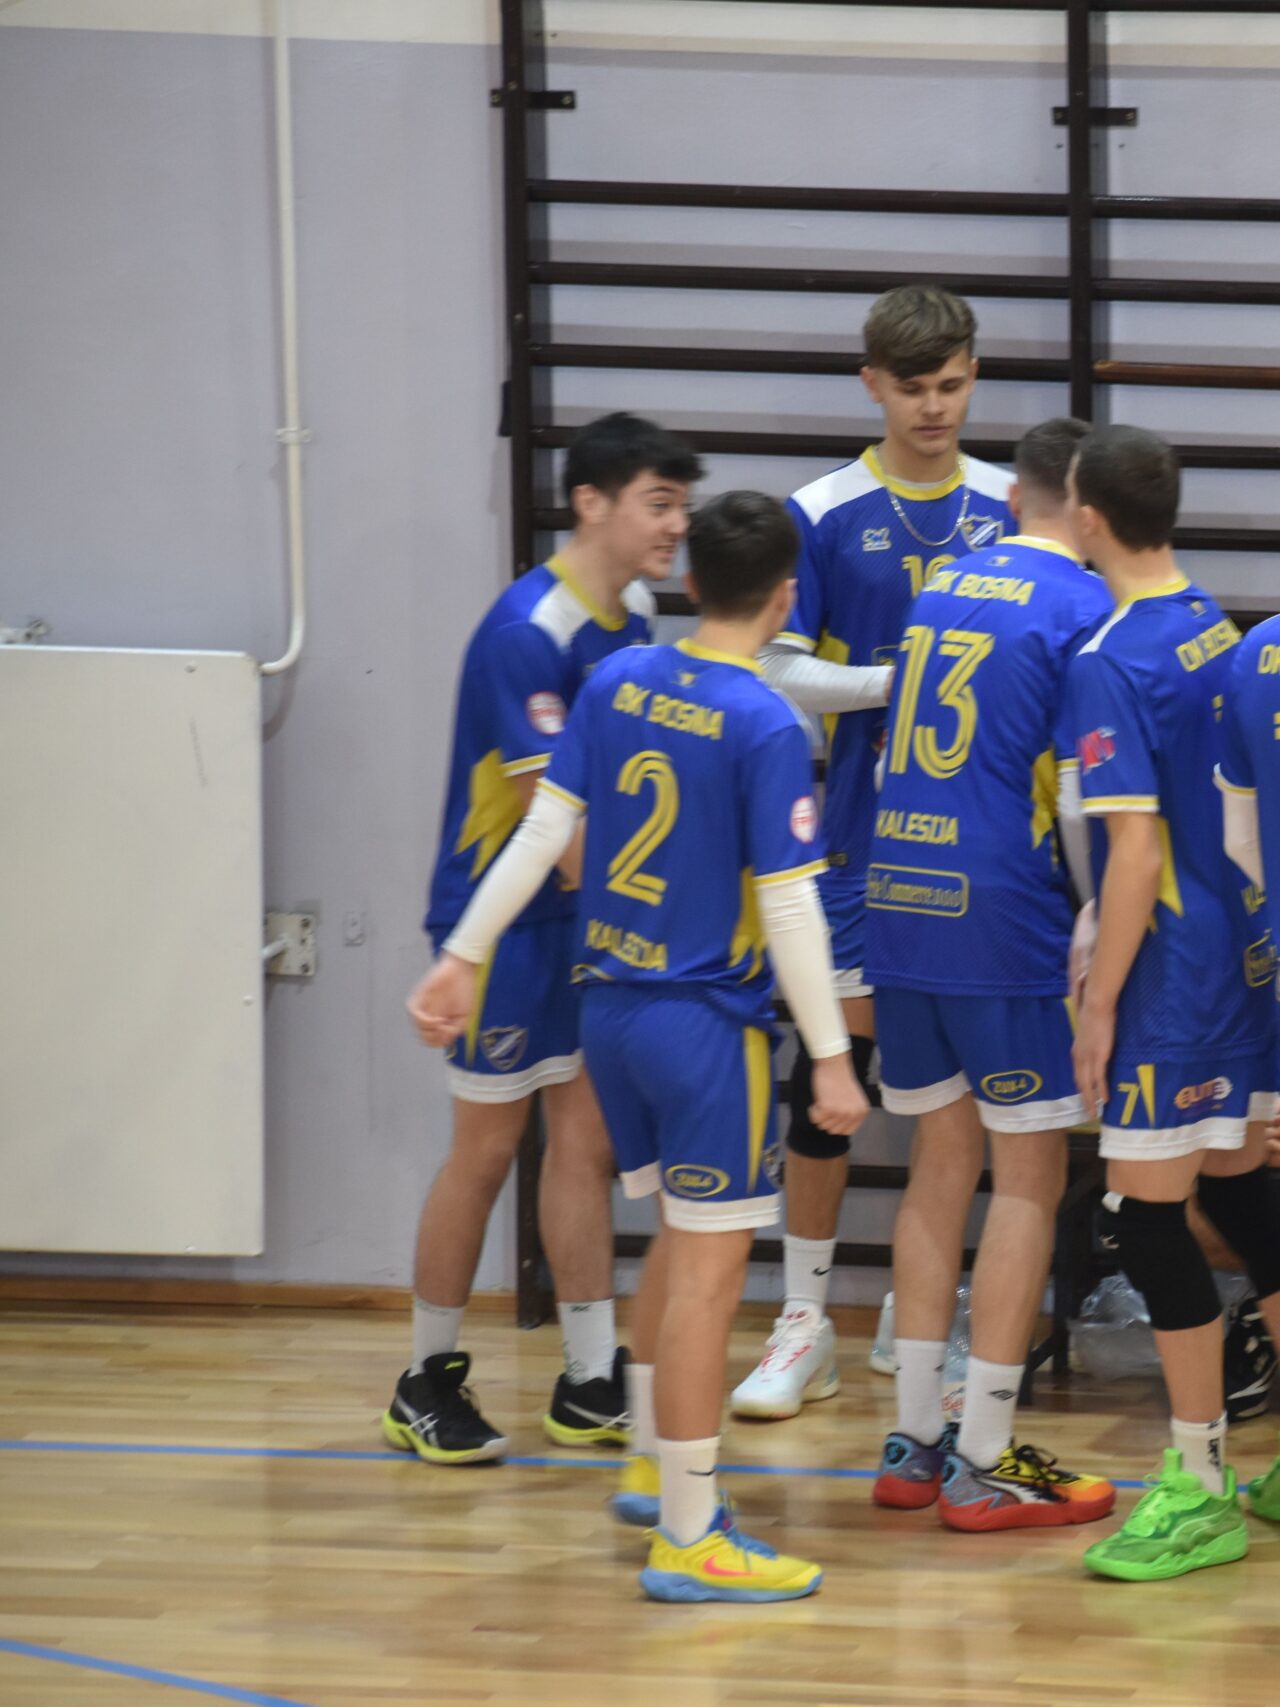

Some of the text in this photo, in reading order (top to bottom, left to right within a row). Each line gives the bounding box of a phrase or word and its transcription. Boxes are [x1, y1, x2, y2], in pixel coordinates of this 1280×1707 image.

[952, 573, 1035, 606] BOSNA
[612, 682, 651, 716] OK
[646, 693, 724, 740] BOSNA
[889, 625, 995, 779] 13
[606, 750, 679, 907] 2
[1117, 1082, 1140, 1126] 7
